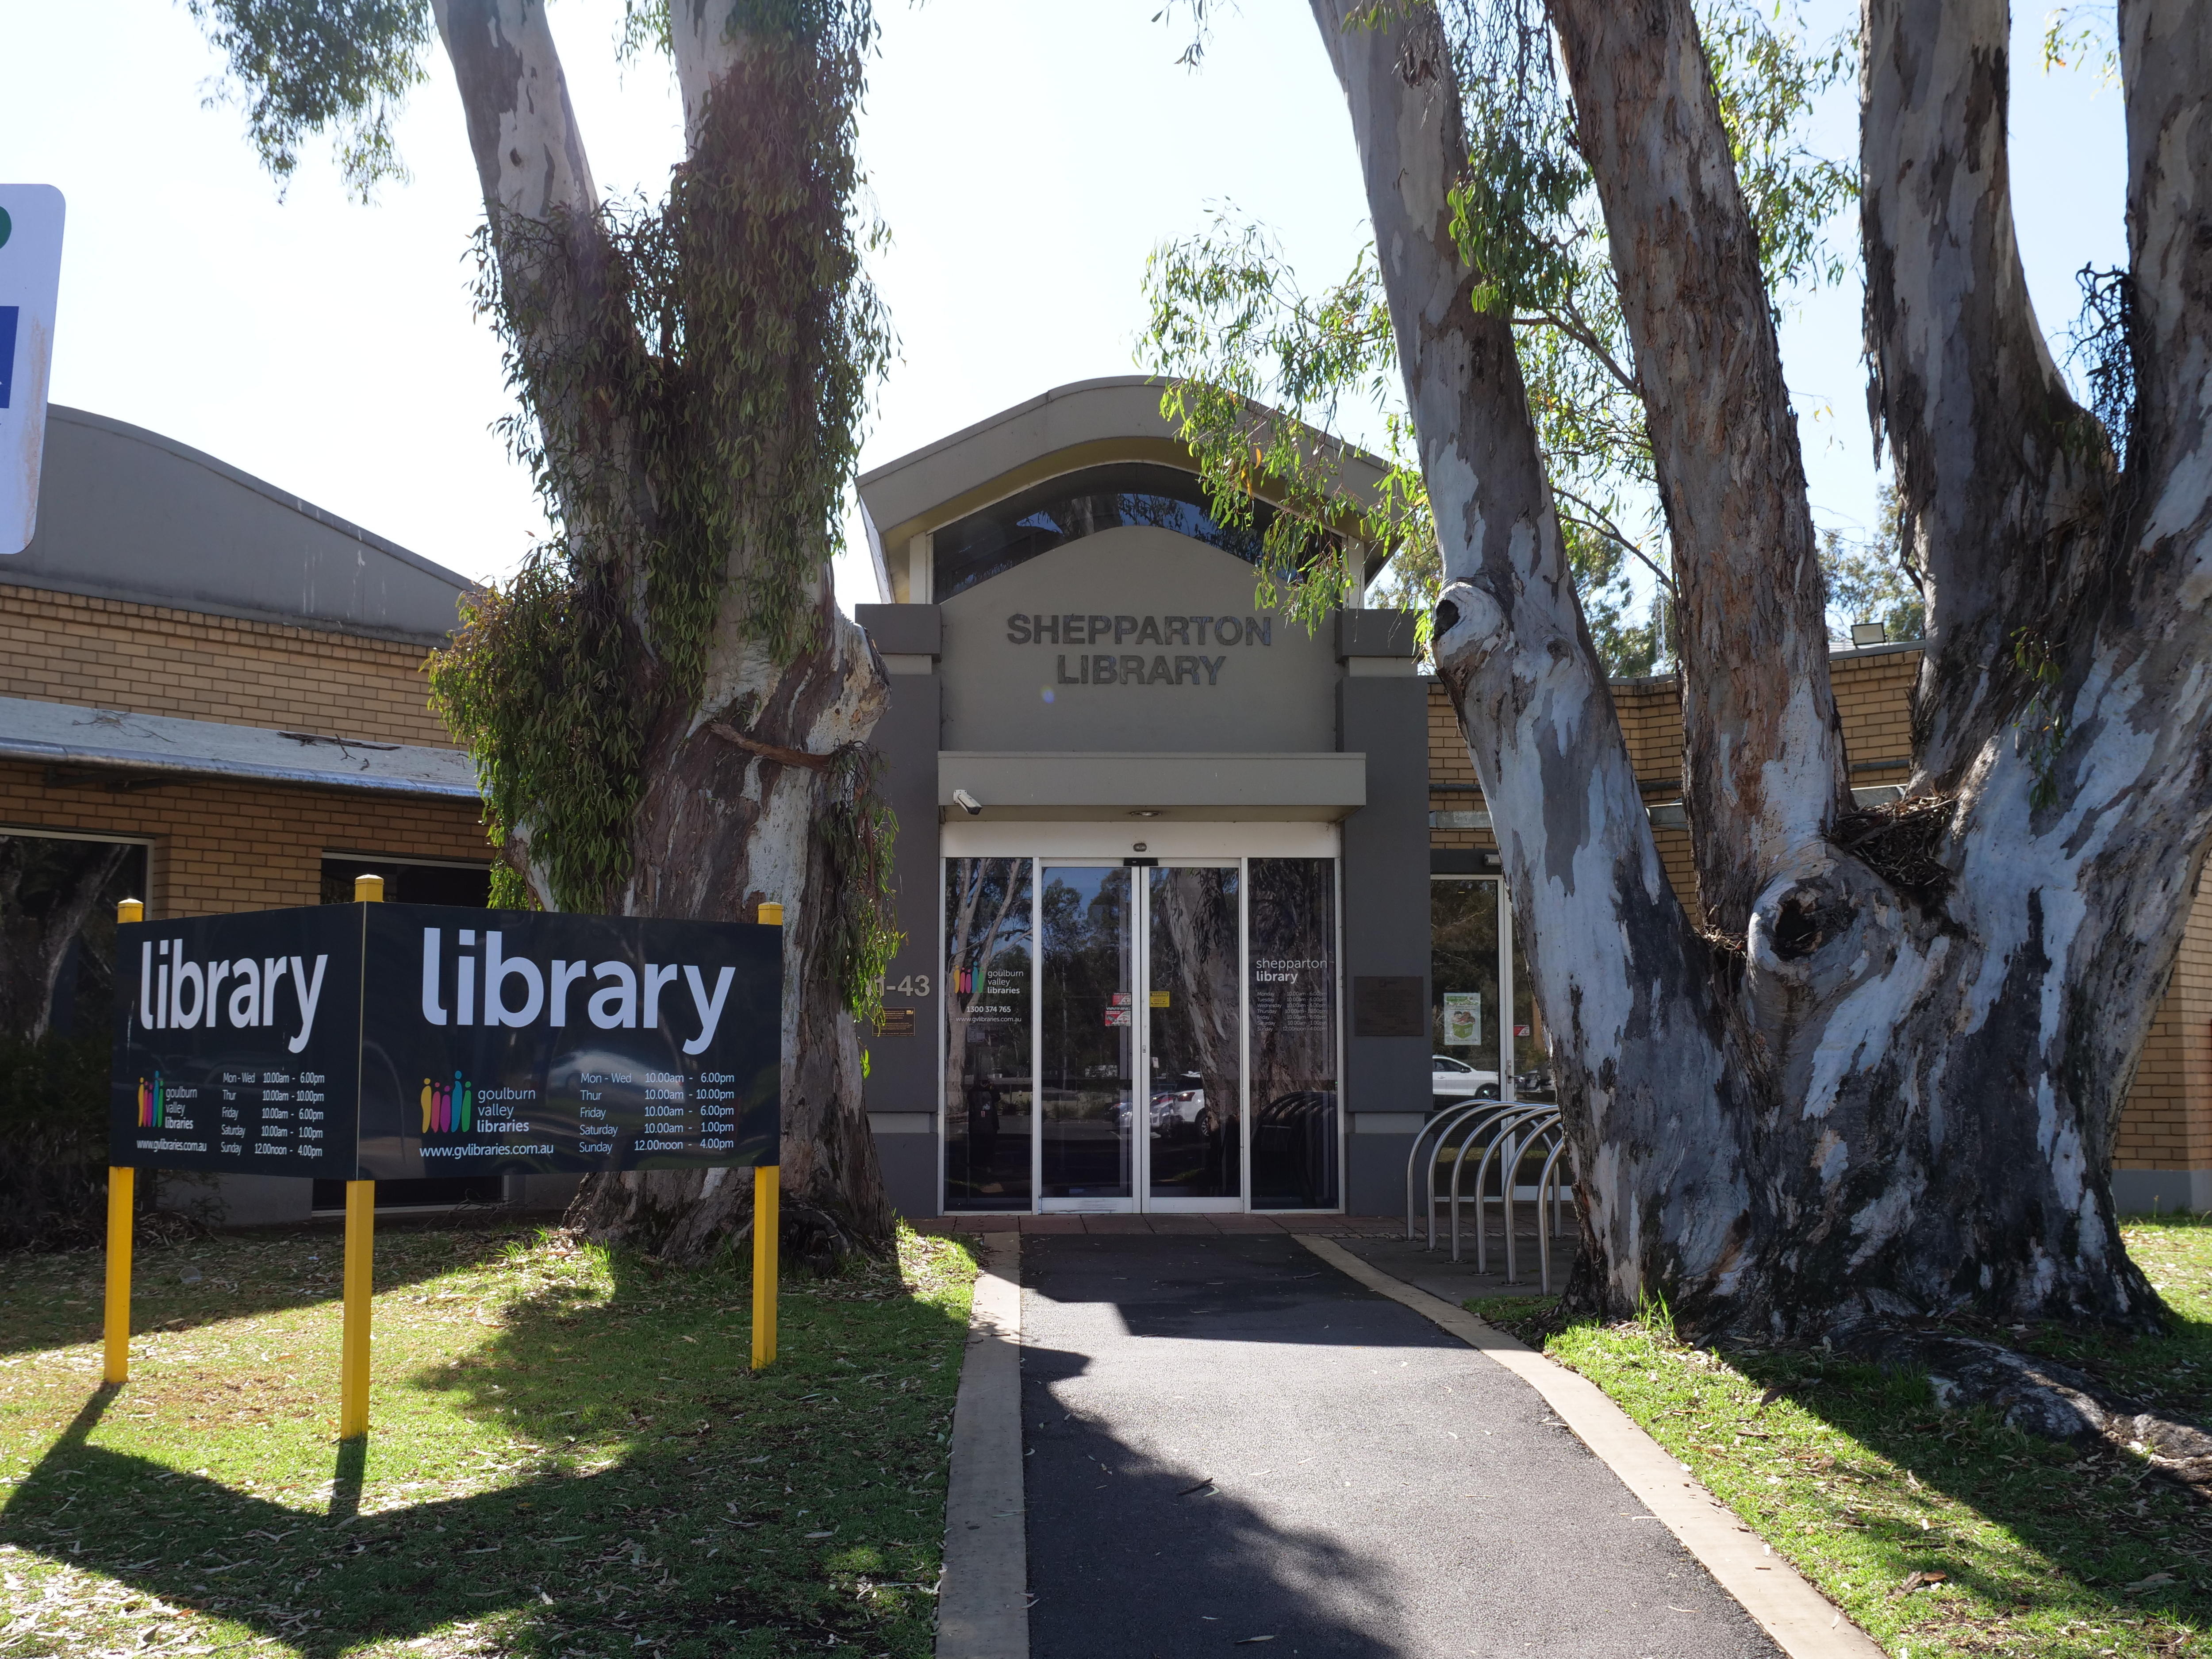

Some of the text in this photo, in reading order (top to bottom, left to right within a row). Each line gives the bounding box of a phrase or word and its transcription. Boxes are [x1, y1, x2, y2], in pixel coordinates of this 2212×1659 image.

[1007, 614, 1271, 646] SHEPPARTON
[1057, 655, 1226, 685] LIBRARY
[1256, 958, 1327, 971] shepparton
[1256, 971, 1298, 984] library
[141, 939, 328, 1053] library
[422, 927, 736, 1055] library
[223, 1072, 237, 1083] Mon
[242, 1072, 255, 1083] Wed
[263, 1072, 289, 1083] 10.00am
[300, 1073, 325, 1085] 6.00pm
[581, 1074, 602, 1083] Mon
[611, 1073, 631, 1083] Wed
[645, 1073, 684, 1083] 10.00am
[700, 1073, 734, 1085] 6.00pm
[166, 1087, 197, 1100] goulburn
[223, 1090, 236, 1101] Thur
[262, 1090, 288, 1101] 10.00am
[296, 1091, 324, 1102] 10.00pm
[478, 1087, 535, 1102] goulburn
[580, 1090, 602, 1100] Thur
[645, 1090, 684, 1100] 10.00am
[696, 1090, 734, 1101] 10.00pm
[166, 1102, 185, 1117] valley
[222, 1107, 238, 1120] Friday
[262, 1108, 288, 1119] 10.00am
[299, 1109, 323, 1121] 6.00pm
[478, 1104, 514, 1118] valley
[580, 1107, 606, 1120] Friday
[645, 1106, 684, 1117] 10.00am
[700, 1106, 734, 1117] 6.00pm
[165, 1117, 194, 1129] libraries
[477, 1120, 529, 1133] libraries
[580, 1124, 618, 1137] Saturday
[644, 1123, 683, 1133] 10.00am
[701, 1122, 734, 1134] 1.00pm
[222, 1125, 245, 1138] Saturday
[261, 1126, 288, 1137] 10.00am
[299, 1126, 323, 1139] 1.00pm
[137, 1139, 207, 1152] www.gvlibraries.com.au
[221, 1142, 242, 1155] Sunday
[254, 1144, 287, 1155] 12.00noon
[297, 1145, 323, 1157] 4.00pm
[419, 1144, 553, 1159] www.gvlibraries.com.au
[579, 1141, 612, 1154] Sunday
[634, 1140, 683, 1150] 12.00noon
[700, 1138, 734, 1150] 4.00pm
